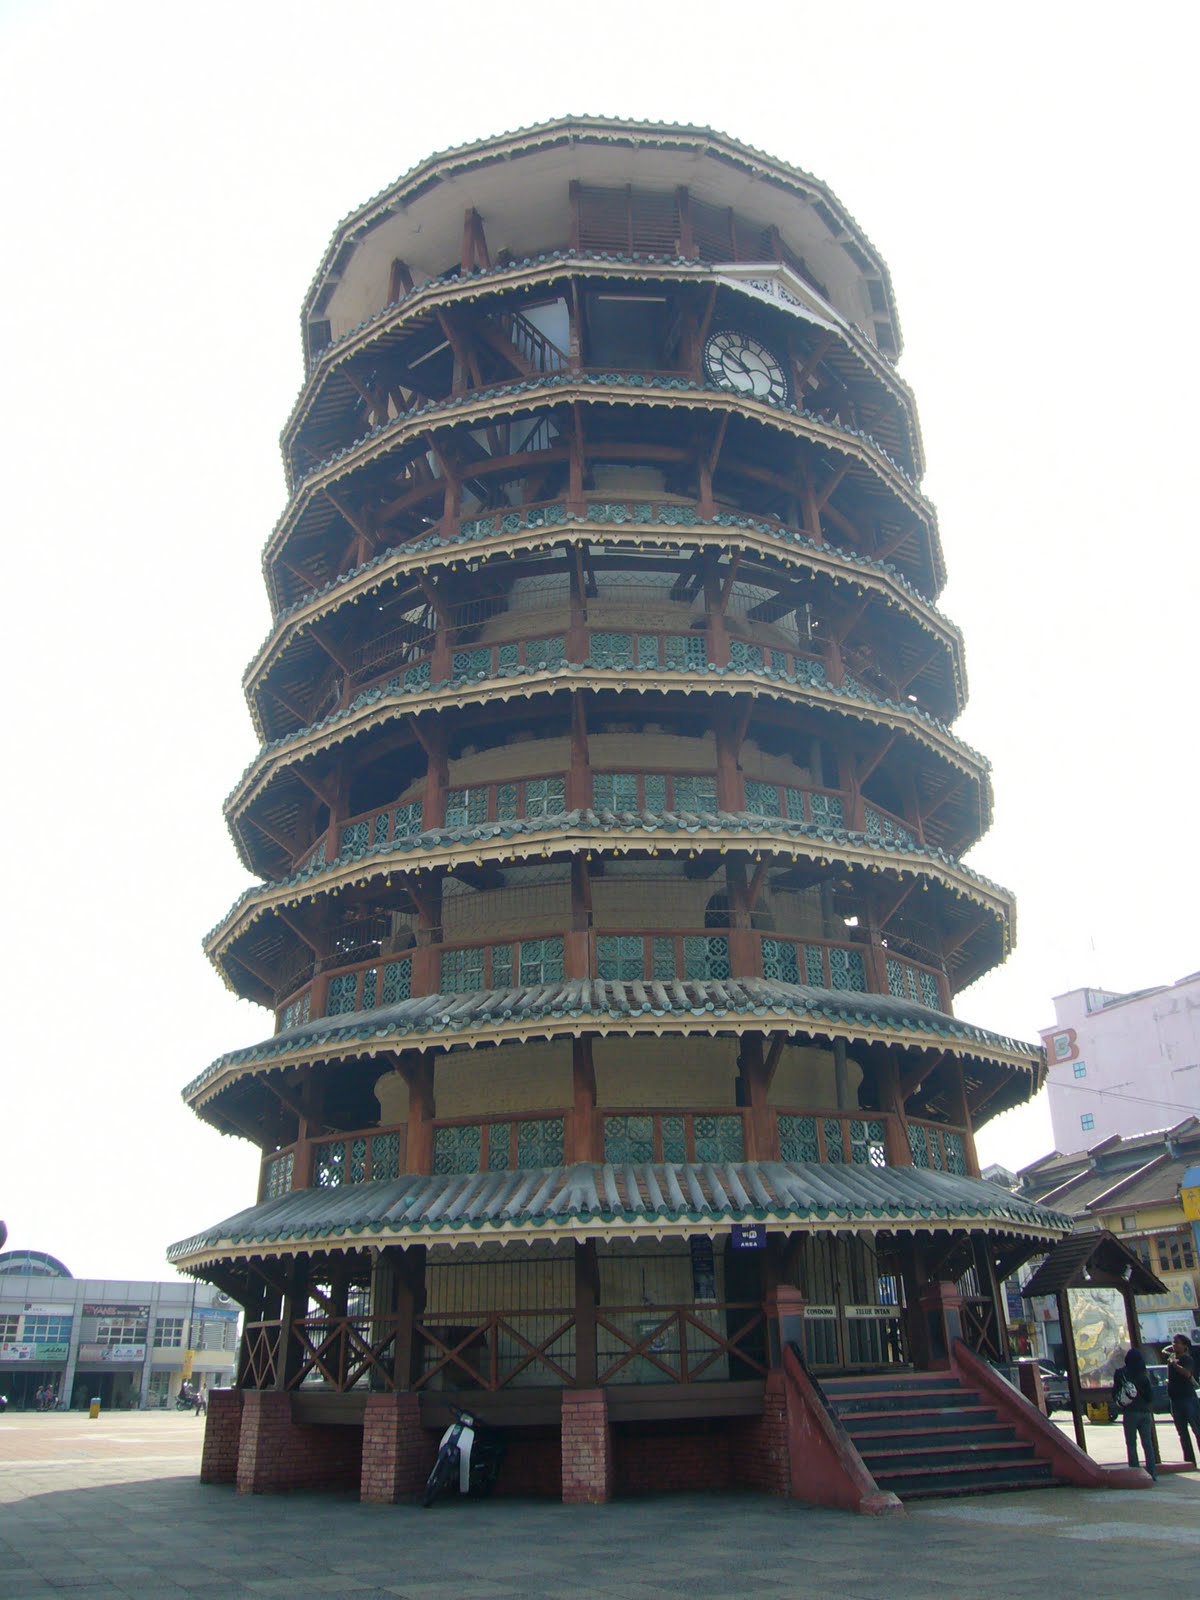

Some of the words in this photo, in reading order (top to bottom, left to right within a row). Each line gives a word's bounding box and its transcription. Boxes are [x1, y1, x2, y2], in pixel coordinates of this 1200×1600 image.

[806, 1307, 833, 1315] CONDONG
[855, 1307, 872, 1315] TELUK
[874, 1307, 891, 1315] INTAN
